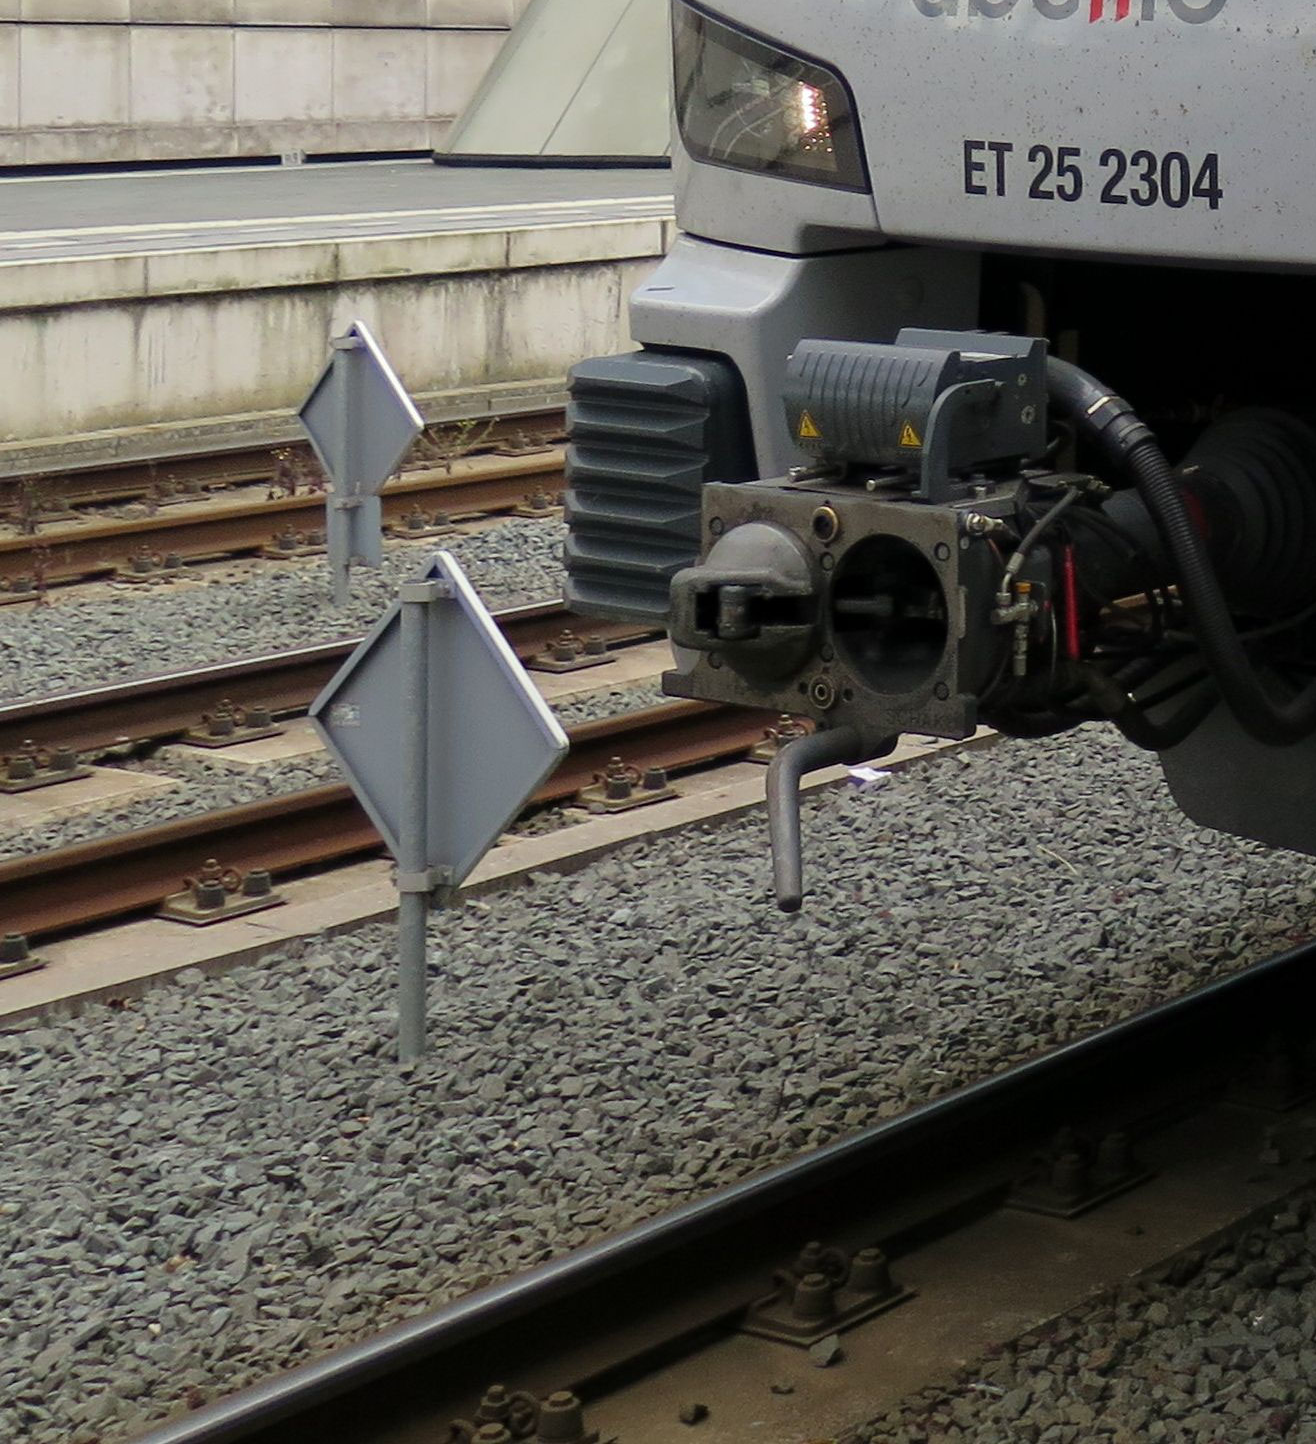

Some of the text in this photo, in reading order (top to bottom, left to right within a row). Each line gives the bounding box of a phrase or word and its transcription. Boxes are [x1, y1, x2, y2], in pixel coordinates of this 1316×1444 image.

[963, 139, 1223, 210] ET 25 2304
